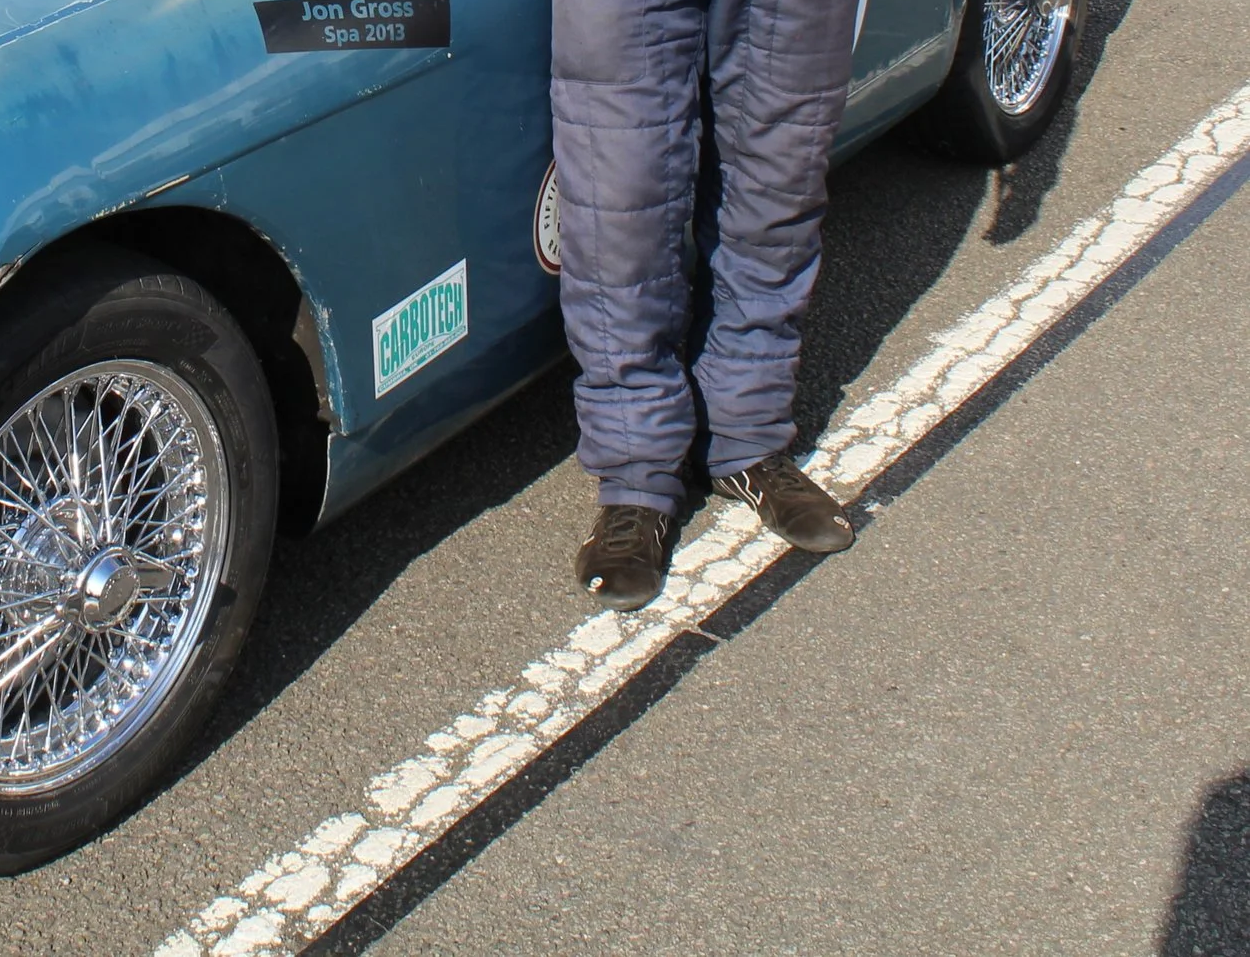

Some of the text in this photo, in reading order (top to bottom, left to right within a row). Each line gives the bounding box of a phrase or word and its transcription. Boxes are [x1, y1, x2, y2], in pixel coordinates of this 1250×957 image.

[301, 1, 344, 21] Jon
[324, 23, 405, 47] Spa 2013
[380, 282, 462, 377] CARBOTECH
